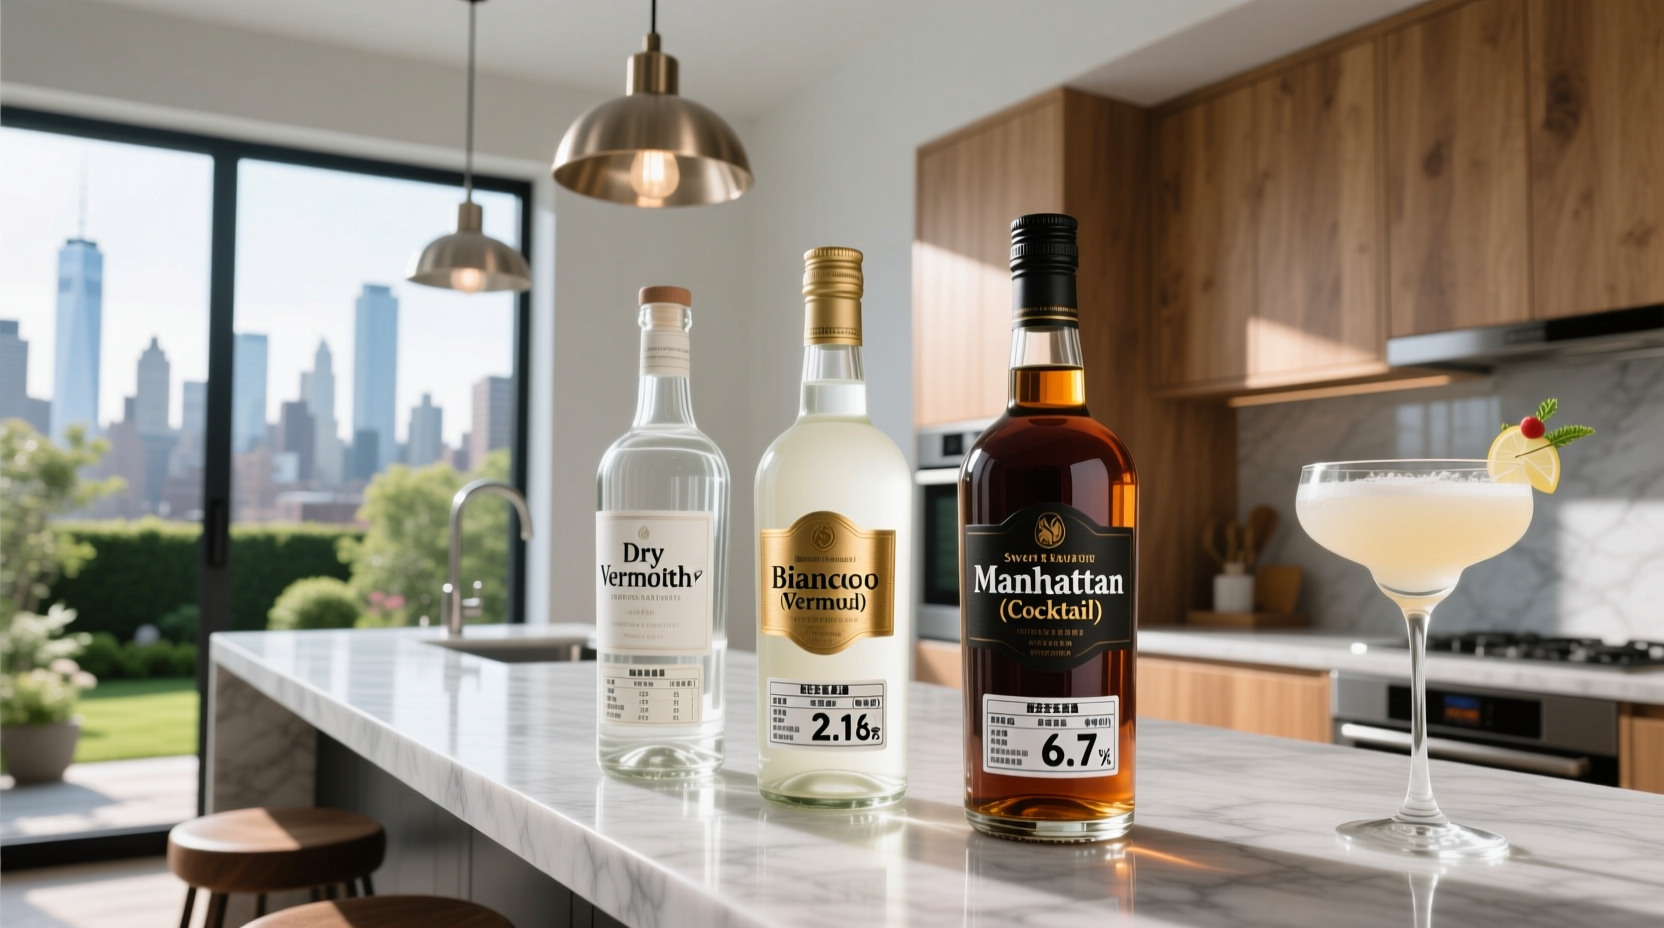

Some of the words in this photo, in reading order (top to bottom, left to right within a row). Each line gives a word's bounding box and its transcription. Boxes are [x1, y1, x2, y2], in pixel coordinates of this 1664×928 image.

[623, 542, 665, 569] Dry
[974, 564, 1125, 595] Manhattan
[1000, 598, 1103, 625] (Cocktail)
